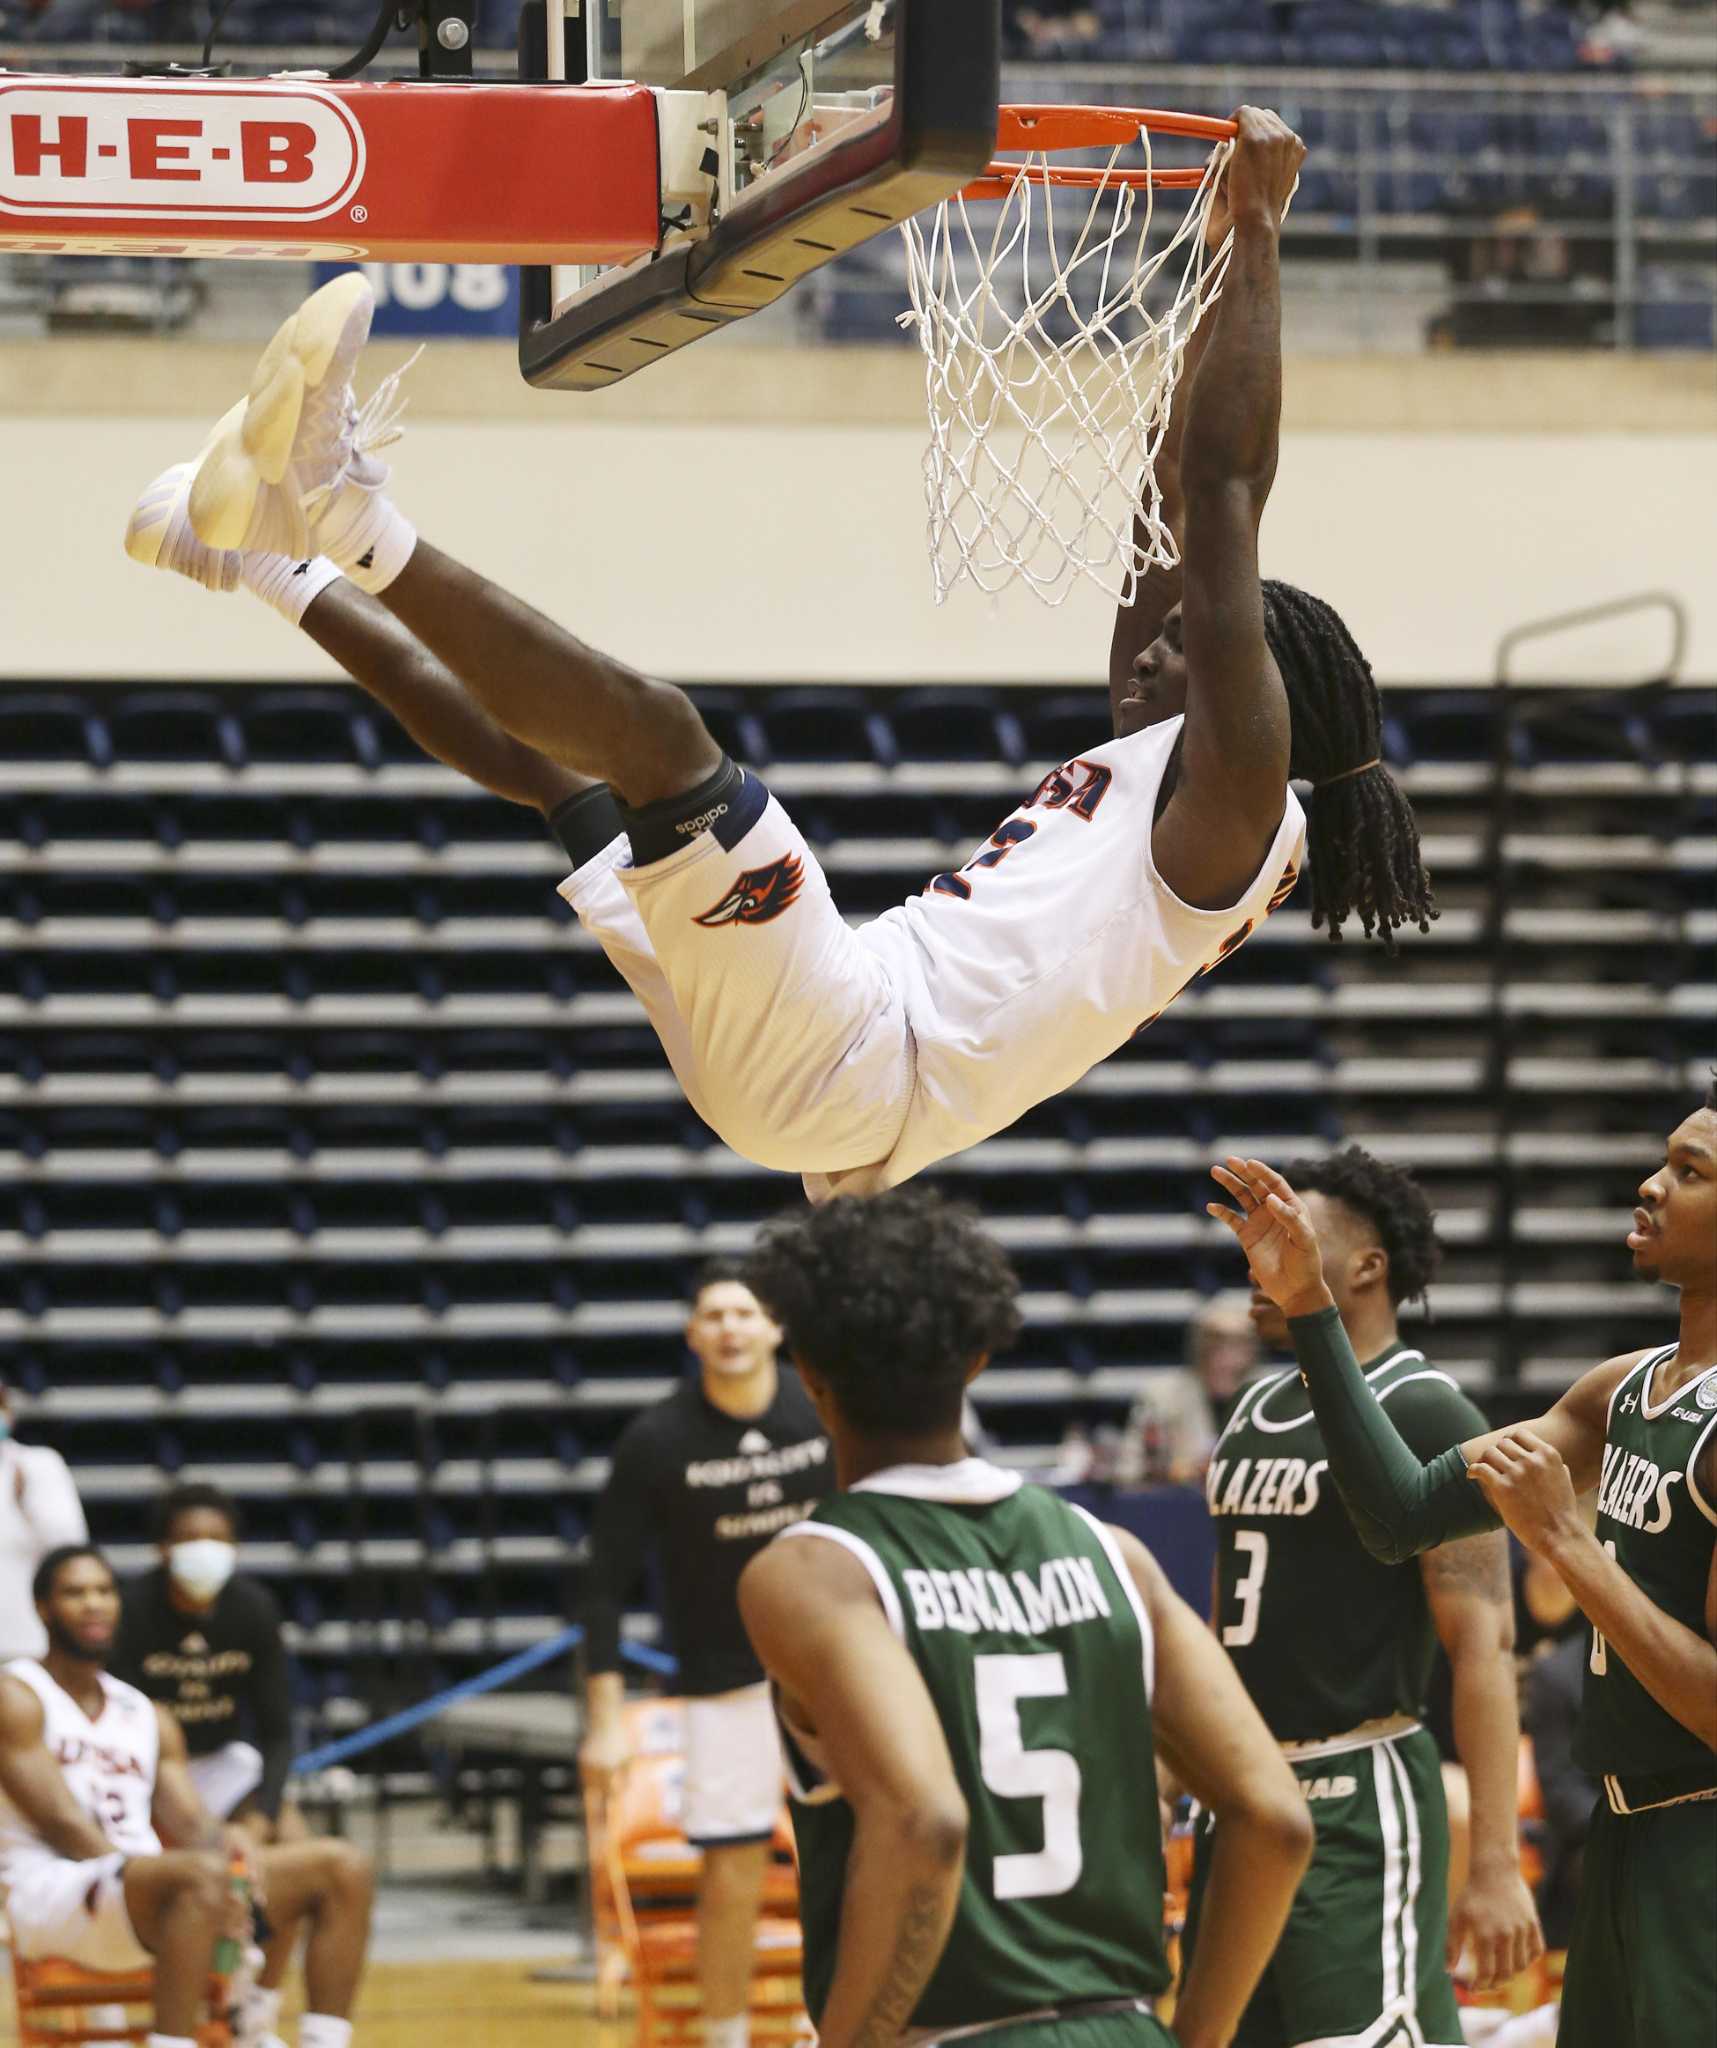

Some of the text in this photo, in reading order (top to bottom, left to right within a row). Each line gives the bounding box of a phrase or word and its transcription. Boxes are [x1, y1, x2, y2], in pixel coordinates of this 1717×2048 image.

[10, 114, 317, 183] H-E-B
[675, 803, 728, 833] adidas
[903, 1557, 1111, 1635] BENJAMIN
[1223, 1530, 1268, 1646] 3
[974, 1652, 1083, 1900] 5
